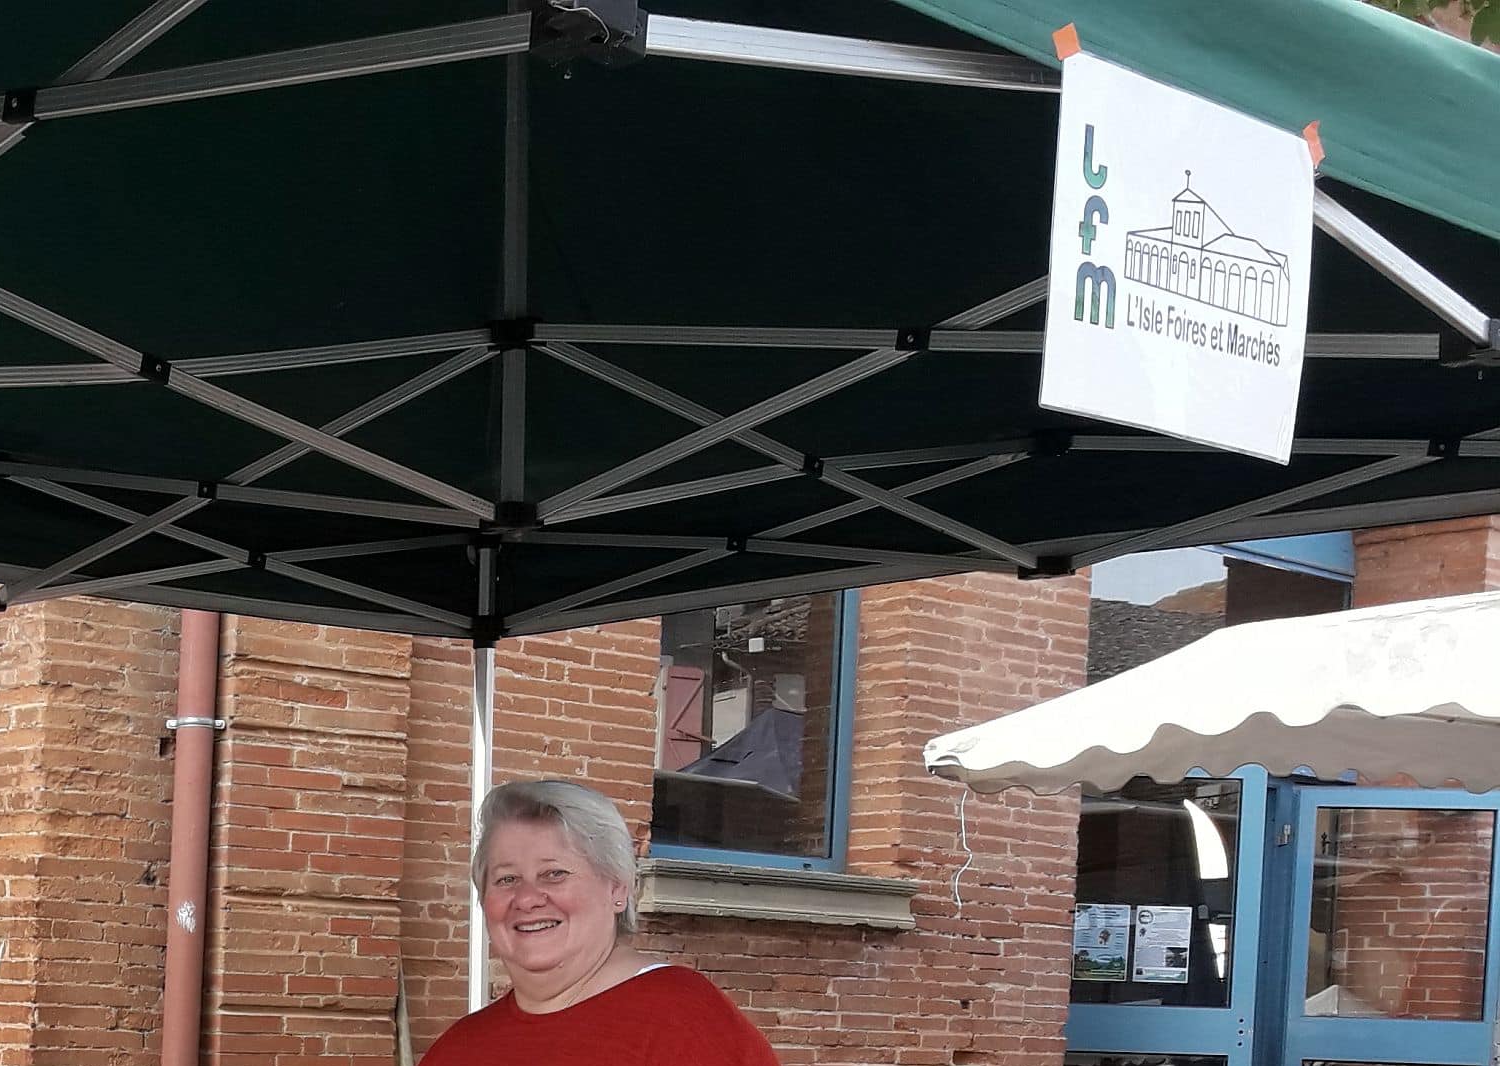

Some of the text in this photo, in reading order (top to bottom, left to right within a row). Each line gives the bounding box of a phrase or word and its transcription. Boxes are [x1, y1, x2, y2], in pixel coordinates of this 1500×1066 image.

[1126, 292, 1281, 367] L'Isle Foires et Marchés
